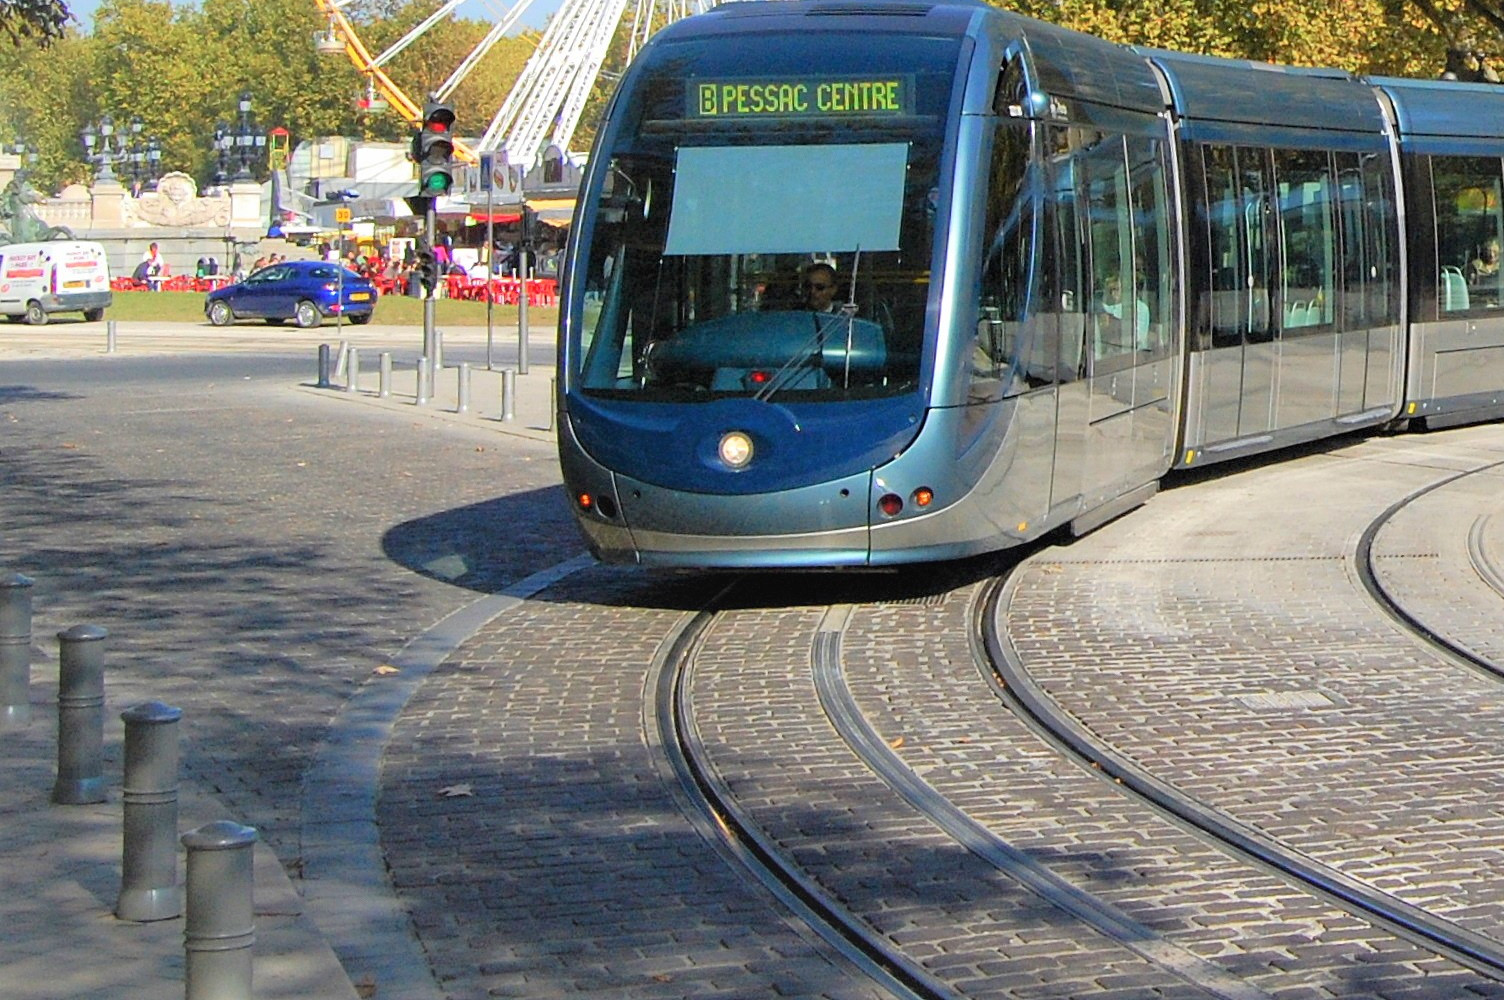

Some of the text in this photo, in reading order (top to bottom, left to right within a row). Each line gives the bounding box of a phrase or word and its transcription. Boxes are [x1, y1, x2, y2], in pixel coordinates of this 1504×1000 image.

[700, 82, 899, 114] B PESSAC CENTRE
